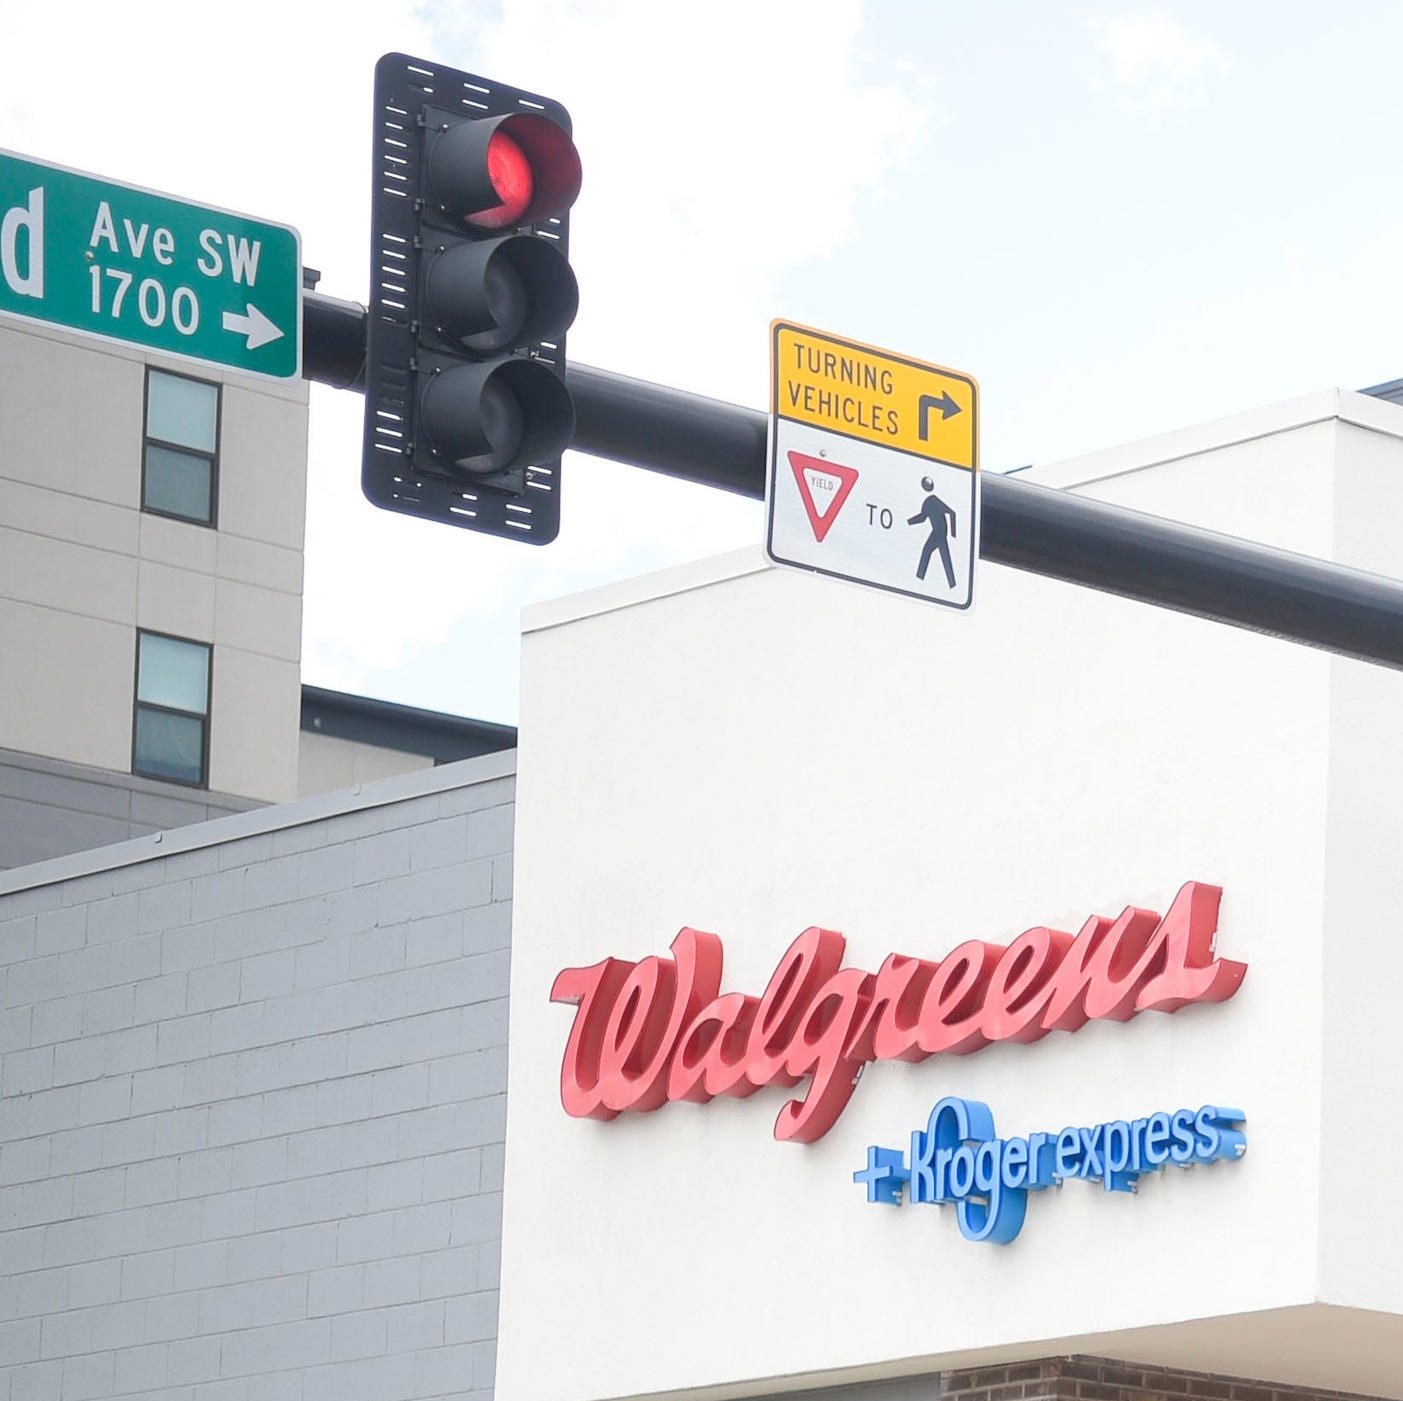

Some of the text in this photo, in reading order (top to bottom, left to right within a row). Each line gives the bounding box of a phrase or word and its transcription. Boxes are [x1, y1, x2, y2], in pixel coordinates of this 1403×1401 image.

[90, 201, 261, 286] Ave SW
[89, 265, 199, 335] 1700
[793, 343, 893, 395] TURNING
[788, 380, 898, 435] VEHICLES
[811, 476, 833, 491] YIELD
[866, 503, 893, 529] TO
[550, 881, 1248, 1142] Walgreens
[1056, 1104, 1247, 1193] express
